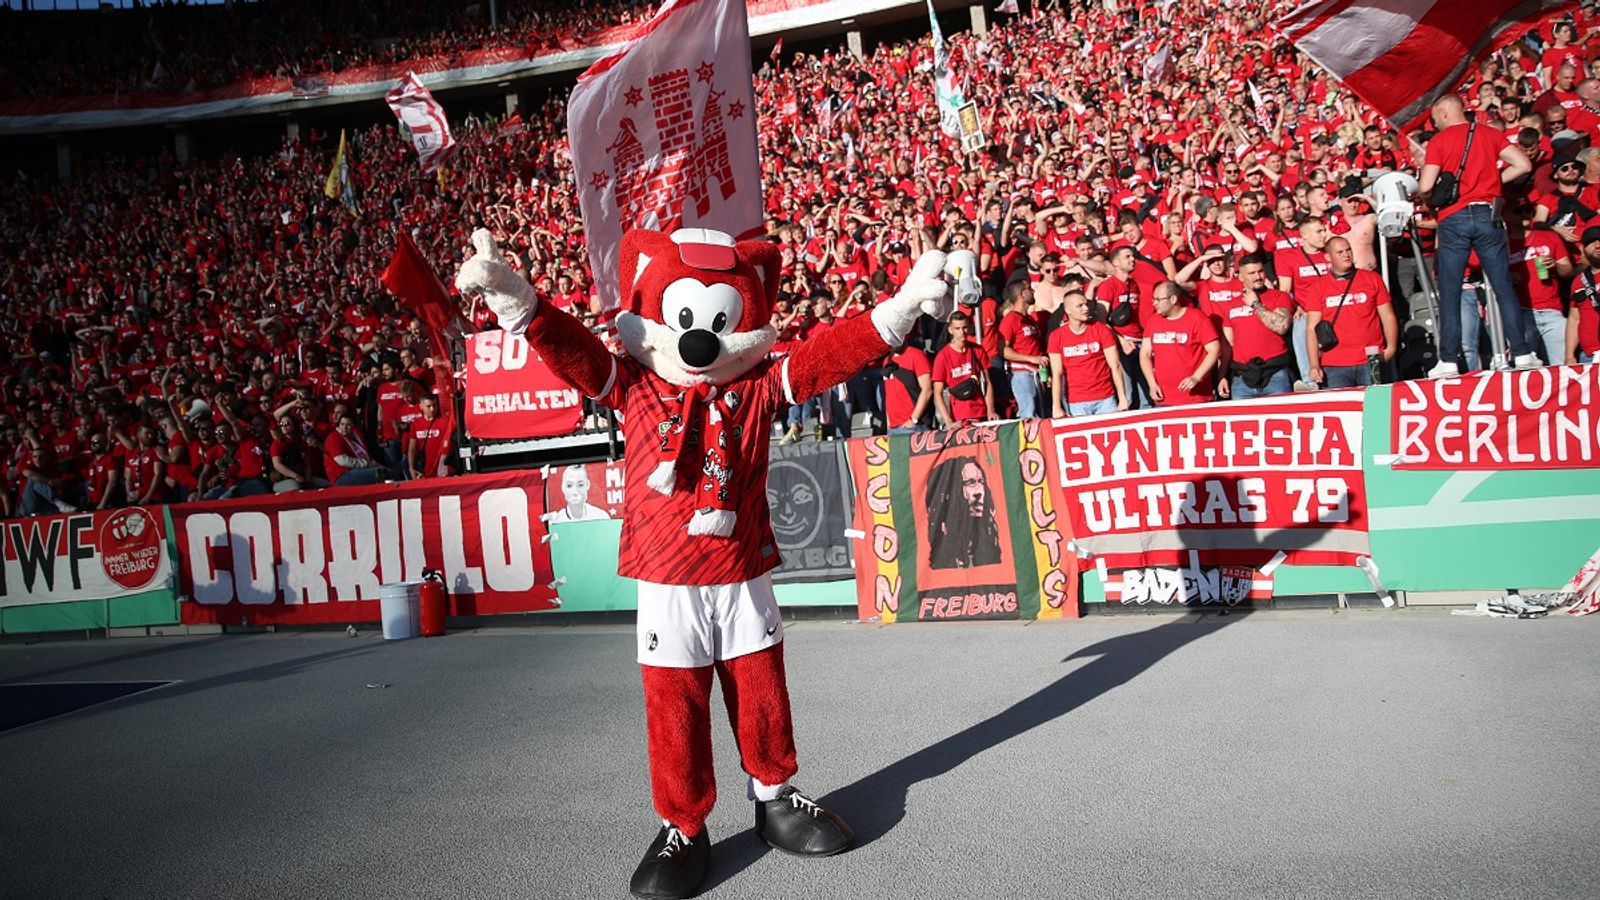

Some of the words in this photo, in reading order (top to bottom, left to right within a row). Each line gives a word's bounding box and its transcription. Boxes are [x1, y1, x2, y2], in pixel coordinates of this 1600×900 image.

[473, 388, 579, 414] ERHALTEN
[1400, 364, 1600, 412] SEZION
[1062, 416, 1354, 481] SYNTHESIA
[1398, 408, 1600, 464] BERLIN
[1079, 478, 1267, 533] ULTRAS
[1286, 477, 1349, 523] 79
[110, 557, 155, 576] FREIBURG
[185, 486, 535, 605] CORRILLO
[1121, 567, 1222, 605] BADEN
[1222, 567, 1251, 578] BADEN
[919, 592, 1018, 618] FREIBURG
